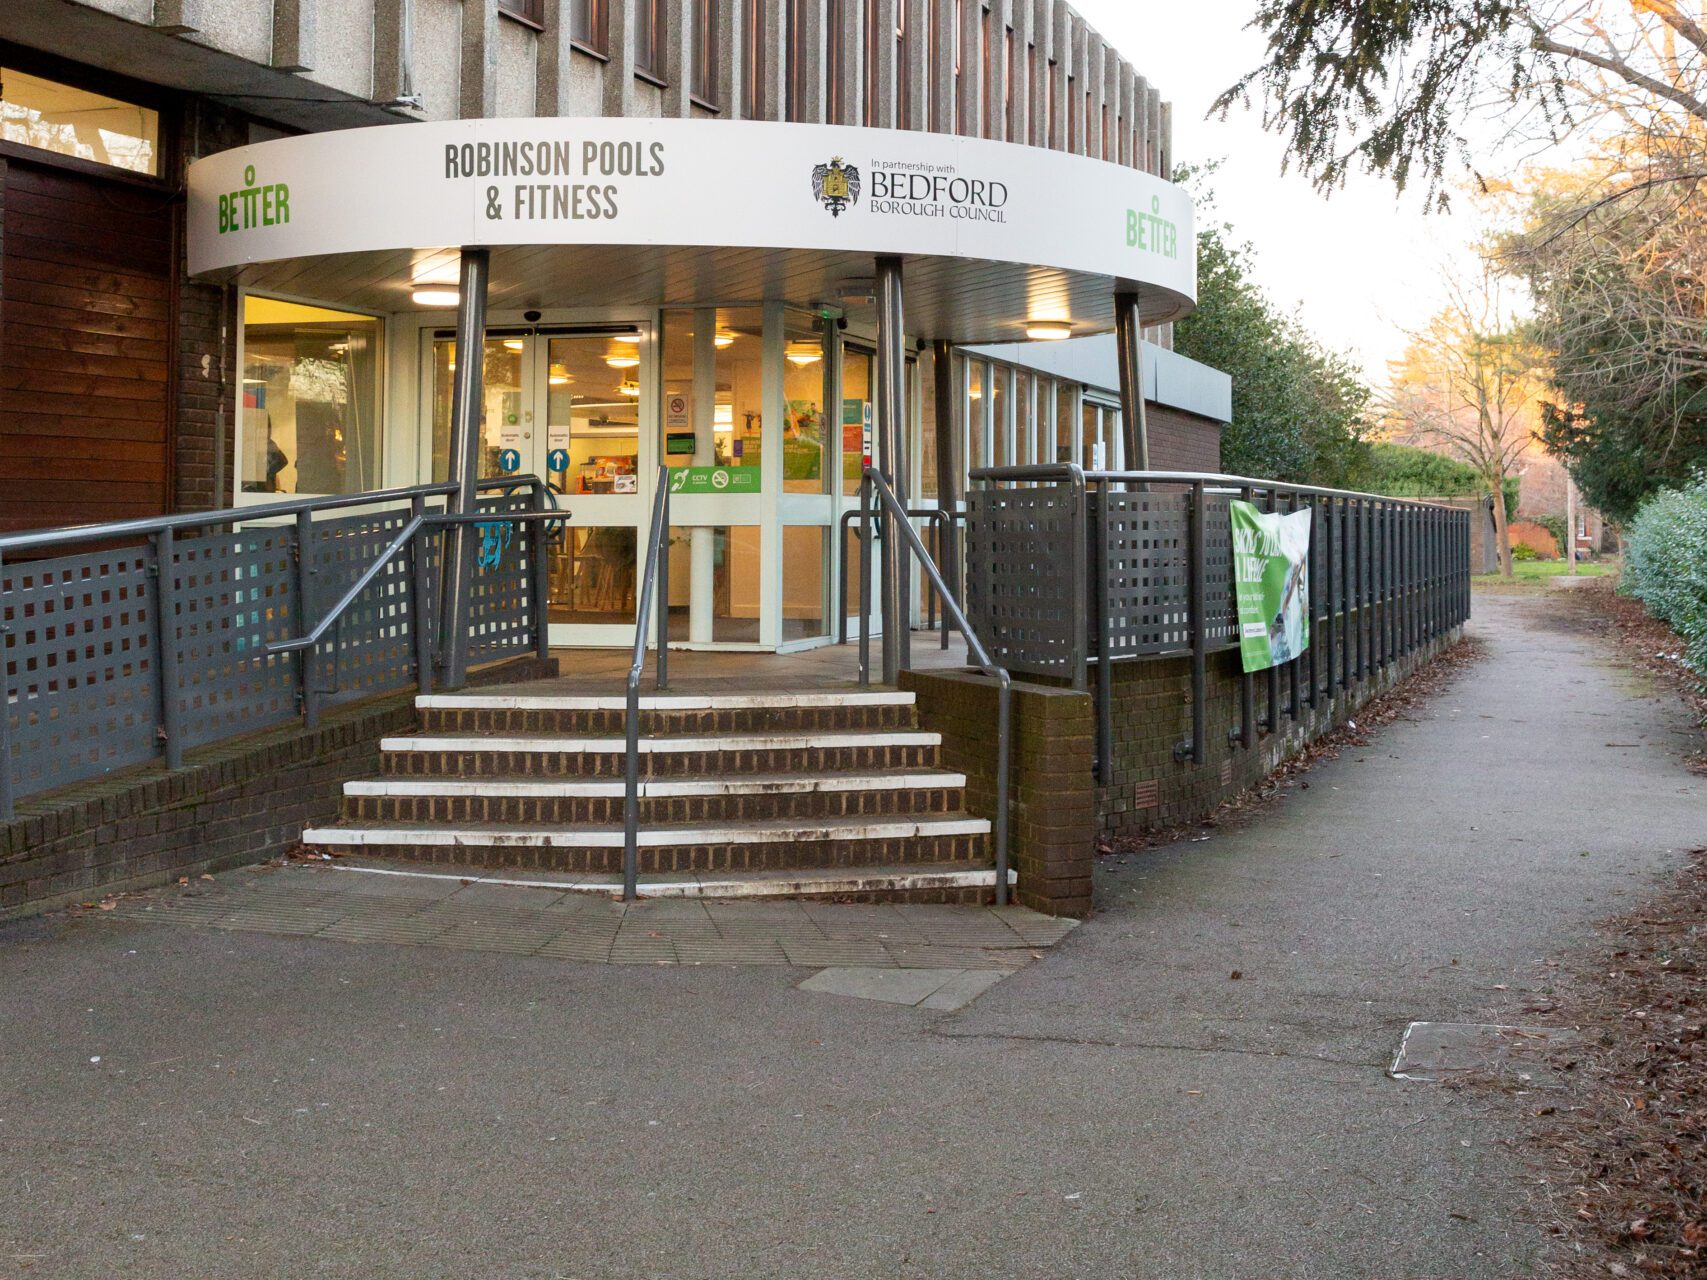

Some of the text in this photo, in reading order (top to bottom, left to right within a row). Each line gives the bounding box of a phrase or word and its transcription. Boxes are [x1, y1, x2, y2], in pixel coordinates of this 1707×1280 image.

[445, 141, 665, 179] ROBINSON POOLS
[871, 159, 956, 173] In partnership with
[486, 185, 618, 220] & FITNESS
[871, 171, 1008, 208] BEDFORD
[219, 183, 289, 234] BETTER
[870, 200, 1007, 223] BOROUGH COUNCIL
[1126, 208, 1176, 260] BETTER
